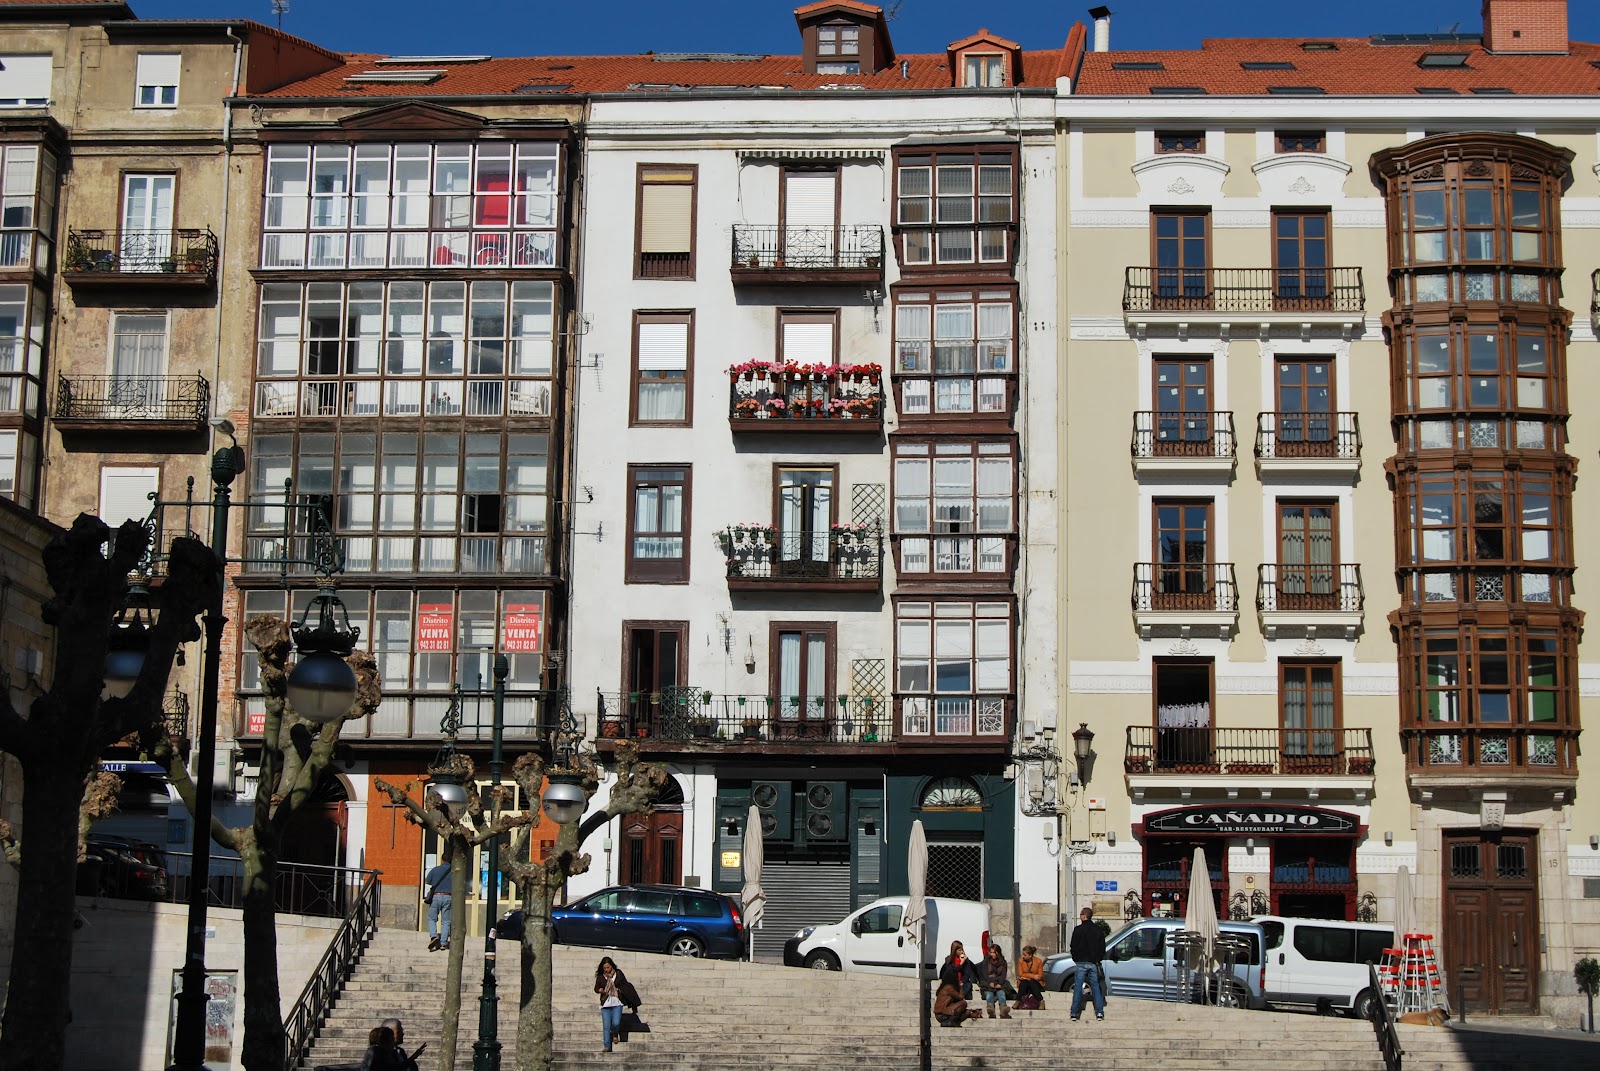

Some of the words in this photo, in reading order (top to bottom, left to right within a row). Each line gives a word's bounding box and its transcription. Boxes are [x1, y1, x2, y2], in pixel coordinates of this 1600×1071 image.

[422, 616, 448, 624] Distrito
[509, 616, 535, 624] Distrito
[421, 628, 448, 638] VENTA
[507, 628, 536, 638] VENTA
[420, 640, 429, 649] 942
[429, 640, 436, 649] 31
[436, 640, 443, 649] 82
[443, 640, 449, 649] 81
[506, 640, 516, 650] 942
[516, 640, 522, 650] 31
[523, 640, 529, 650] 82
[529, 640, 536, 650] 81
[251, 715, 266, 724] VEN
[102, 764, 127, 772] ALLE
[1184, 811, 1319, 826] CAÑADIO
[1548, 859, 1558, 868] 15
